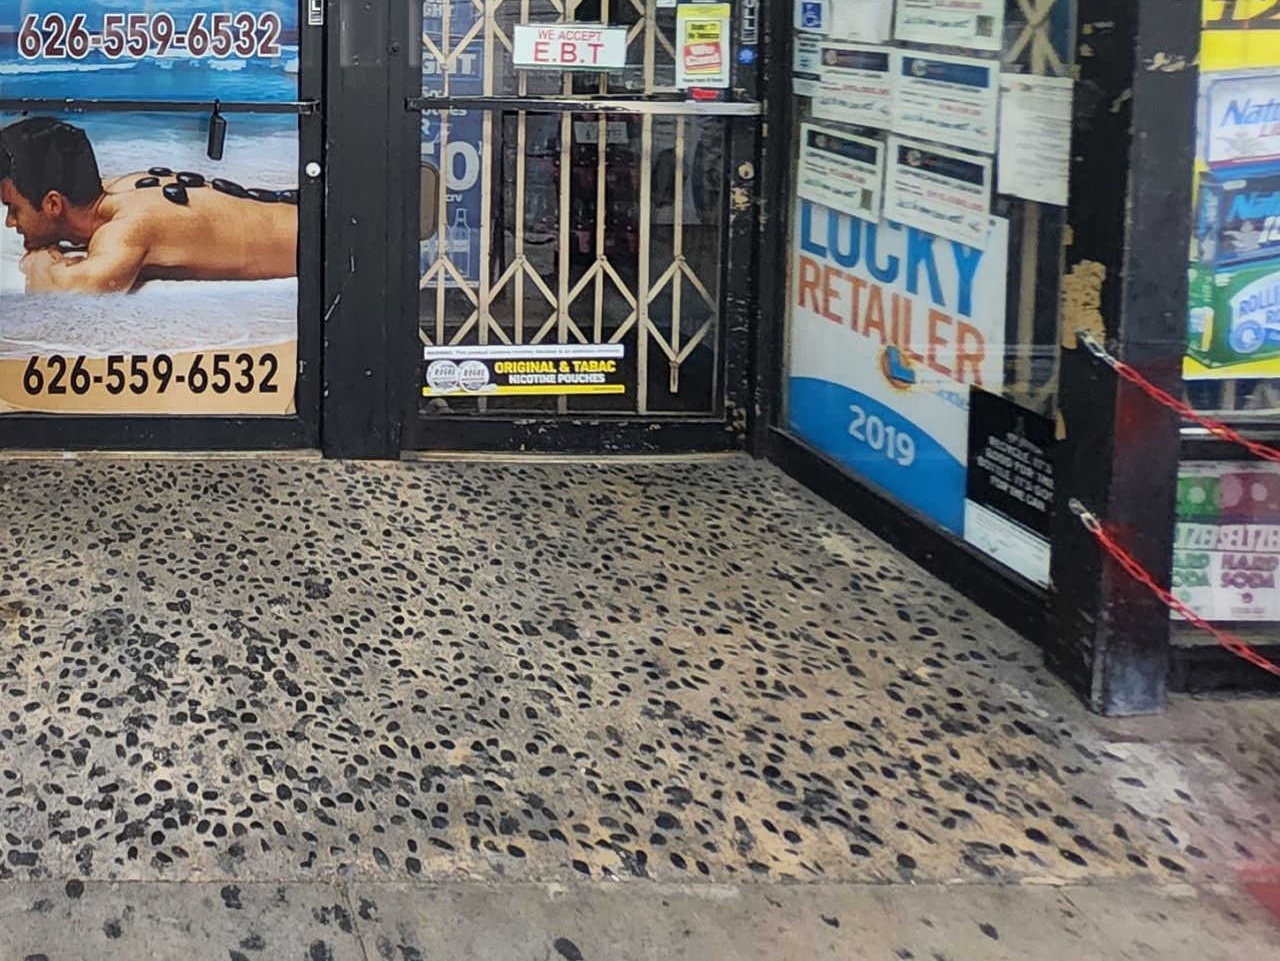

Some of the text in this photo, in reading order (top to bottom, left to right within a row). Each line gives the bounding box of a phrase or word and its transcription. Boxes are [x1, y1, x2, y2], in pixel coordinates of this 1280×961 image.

[18, 11, 282, 59] 626-559-6532
[533, 41, 605, 64] E.B.T
[538, 29, 603, 41] WE ACCEPT
[800, 200, 984, 317] LUCKY
[797, 254, 985, 385] RETAILER
[23, 353, 279, 395] 626-559-6532
[494, 360, 616, 374] ORIGINAL & TABAC
[508, 373, 606, 384] NICOTINE POUCHES
[848, 404, 916, 466] 2019
